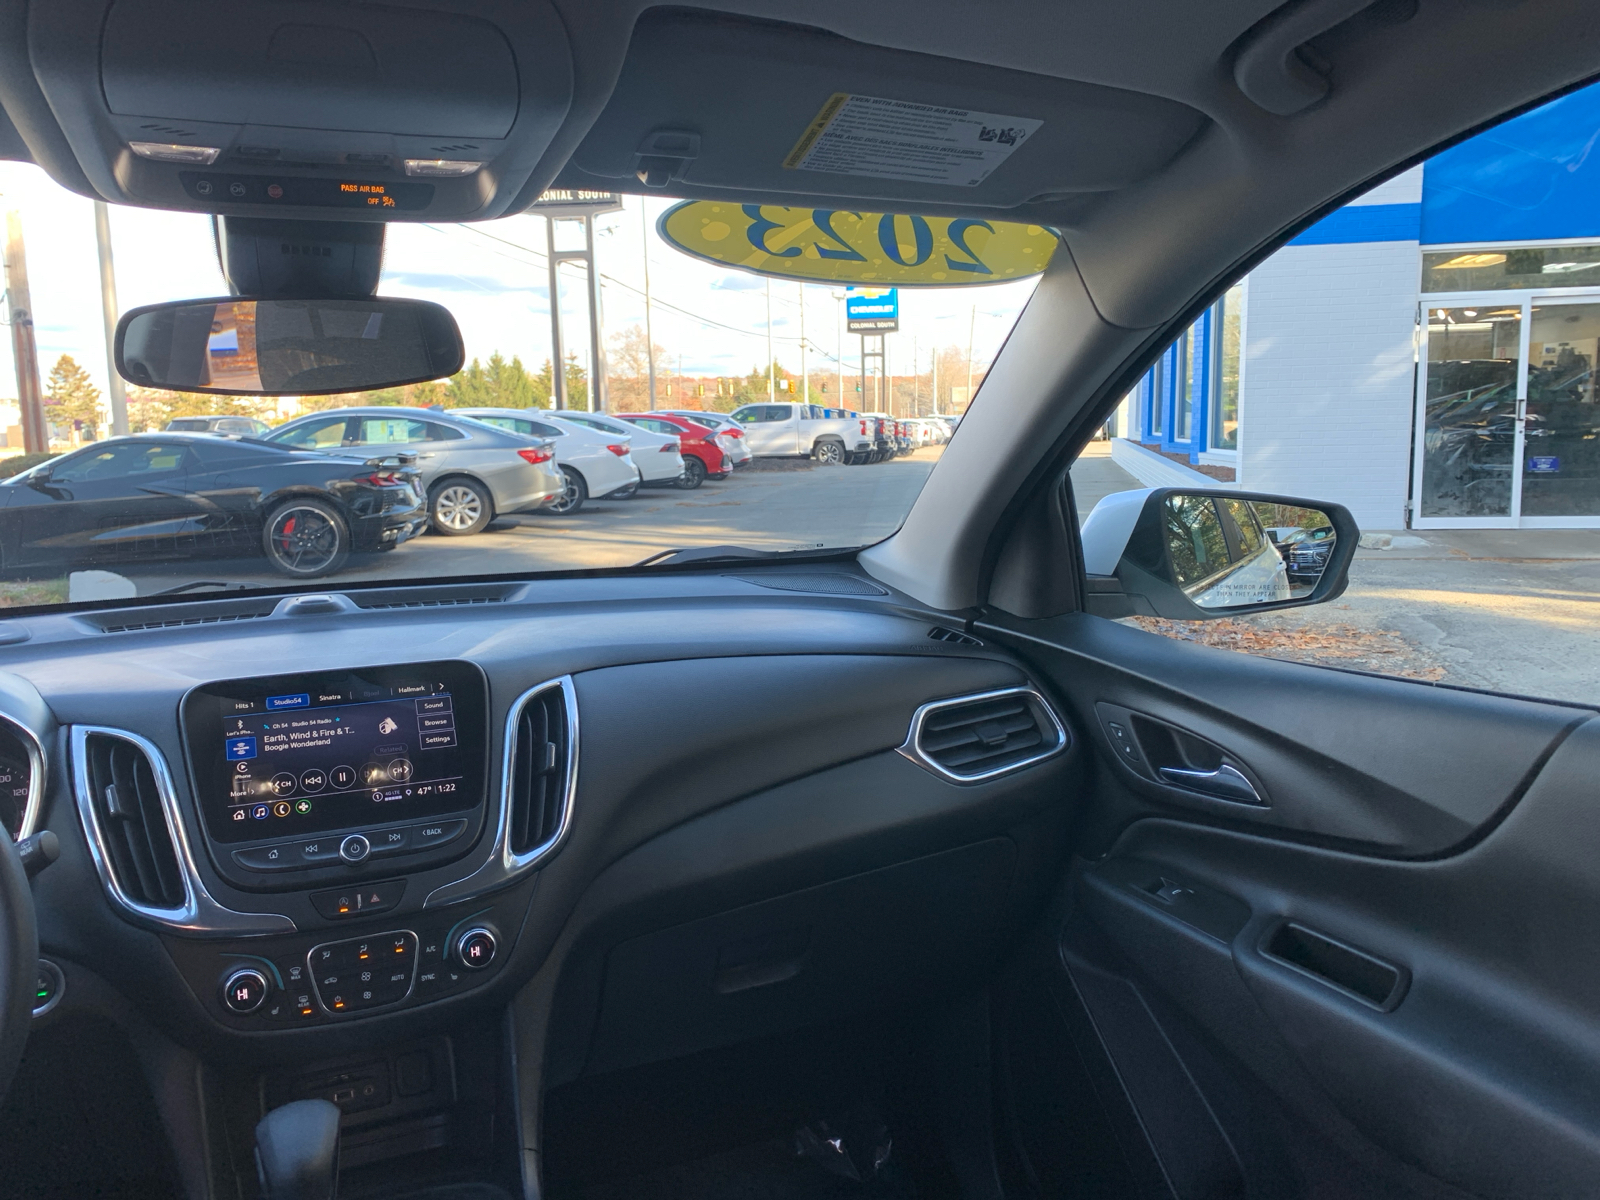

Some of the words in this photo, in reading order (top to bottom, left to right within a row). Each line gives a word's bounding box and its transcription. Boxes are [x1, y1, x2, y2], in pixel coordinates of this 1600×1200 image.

[341, 184, 358, 192] PASS
[539, 190, 573, 202] LONIAL
[367, 197, 379, 205] OFF
[398, 685, 426, 693] Hallmark
[319, 693, 341, 701] Sinatra
[273, 697, 302, 706] Studio54
[264, 733, 288, 743] Earth,
[289, 731, 310, 740] Wind
[425, 736, 450, 744] Settings
[264, 743, 289, 752] Boogie
[290, 738, 331, 748] Wonderland
[379, 745, 403, 753] Related
[13, 788, 28, 796] 120
[438, 784, 456, 793] 1:22
[471, 946, 481, 957] HI
[421, 973, 435, 981] SYNC
[237, 988, 248, 1000] HI
